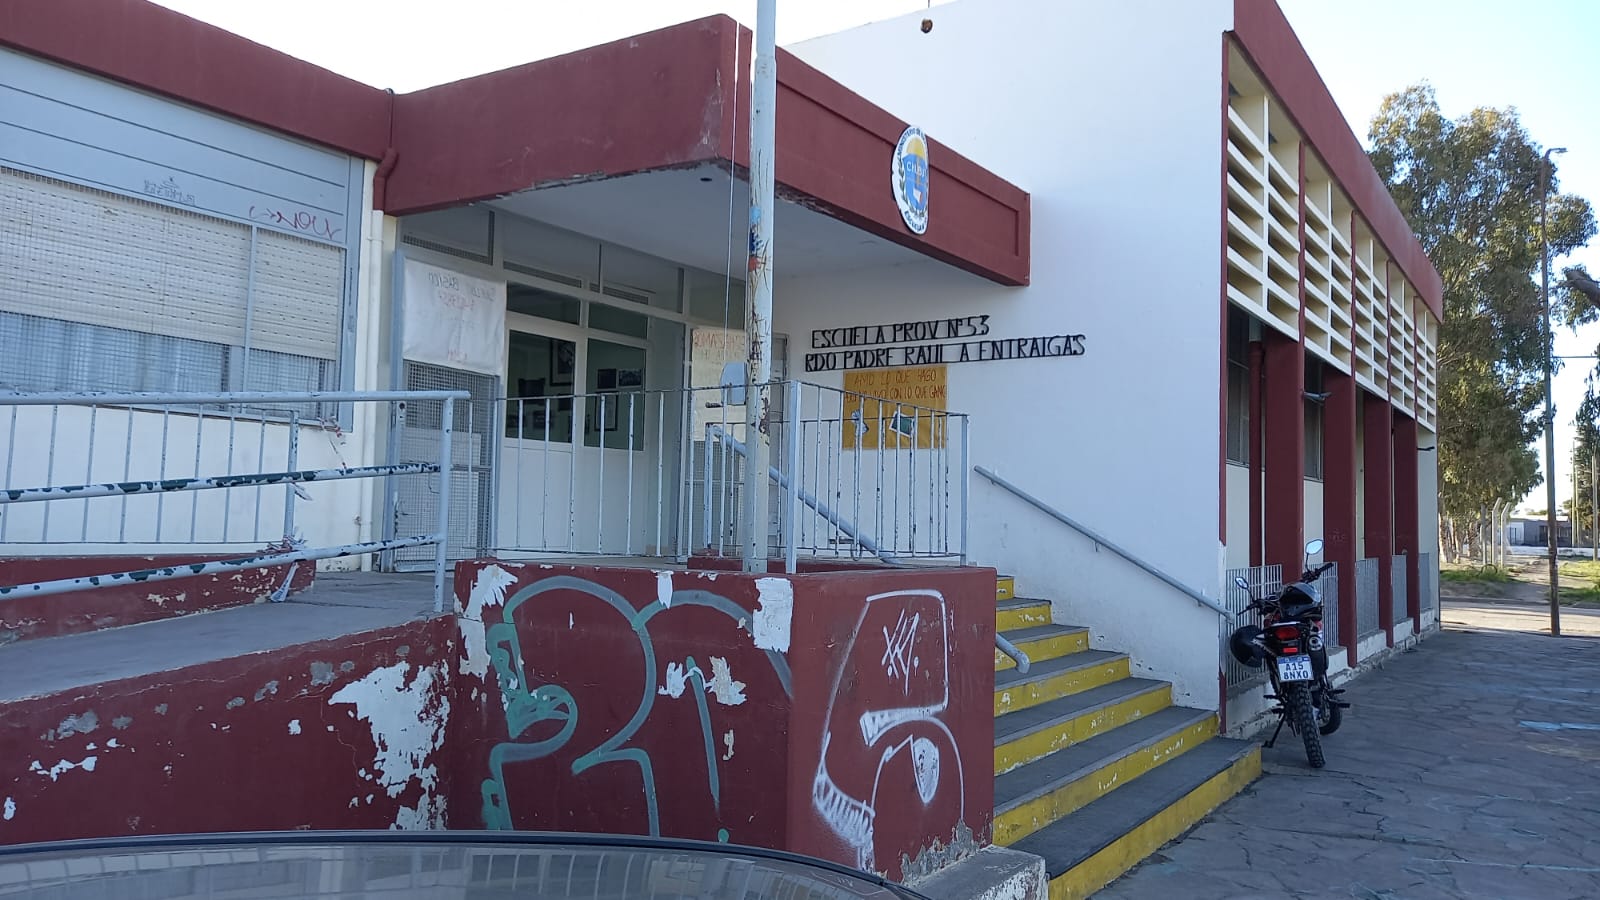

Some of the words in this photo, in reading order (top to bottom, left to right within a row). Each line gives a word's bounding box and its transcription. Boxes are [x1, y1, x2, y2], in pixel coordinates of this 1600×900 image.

[811, 325, 885, 349] ESCUELA
[893, 319, 939, 342] PROV
[805, 351, 837, 372] RDO
[844, 346, 894, 370] PADRE
[905, 343, 948, 366] RAUL
[960, 342, 970, 362] A
[979, 333, 1086, 361] ENTRAIGAS
[1286, 662, 1303, 670] A15
